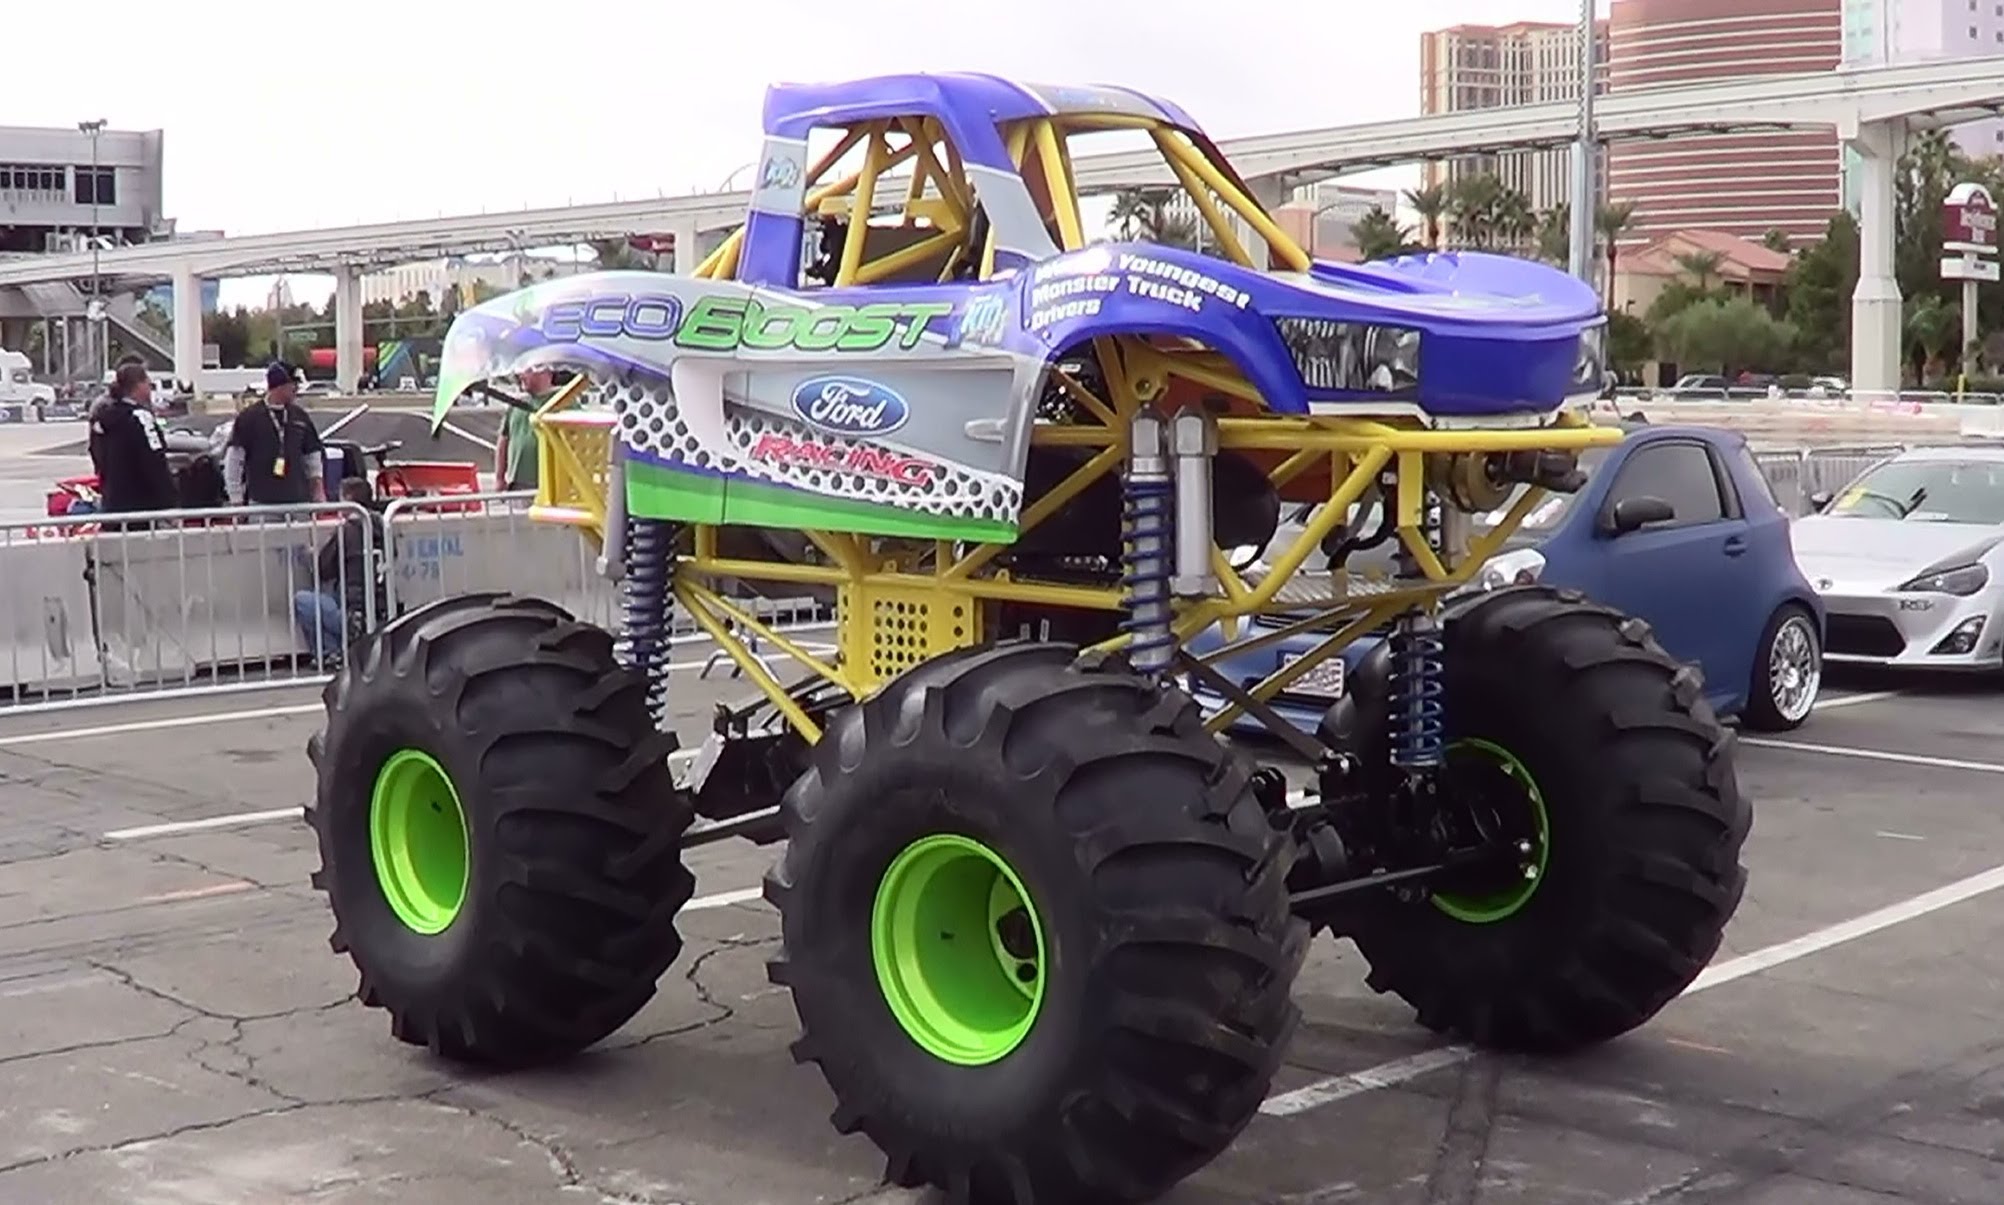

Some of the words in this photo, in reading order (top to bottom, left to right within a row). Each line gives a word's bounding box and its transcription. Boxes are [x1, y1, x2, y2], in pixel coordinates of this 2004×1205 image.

[1032, 274, 1120, 307] Monster
[1127, 274, 1202, 312] Truck
[1119, 254, 1250, 310] Youngest
[1031, 298, 1101, 331] Drivers
[811, 382, 887, 429] Ford
[752, 434, 936, 487] RACING
